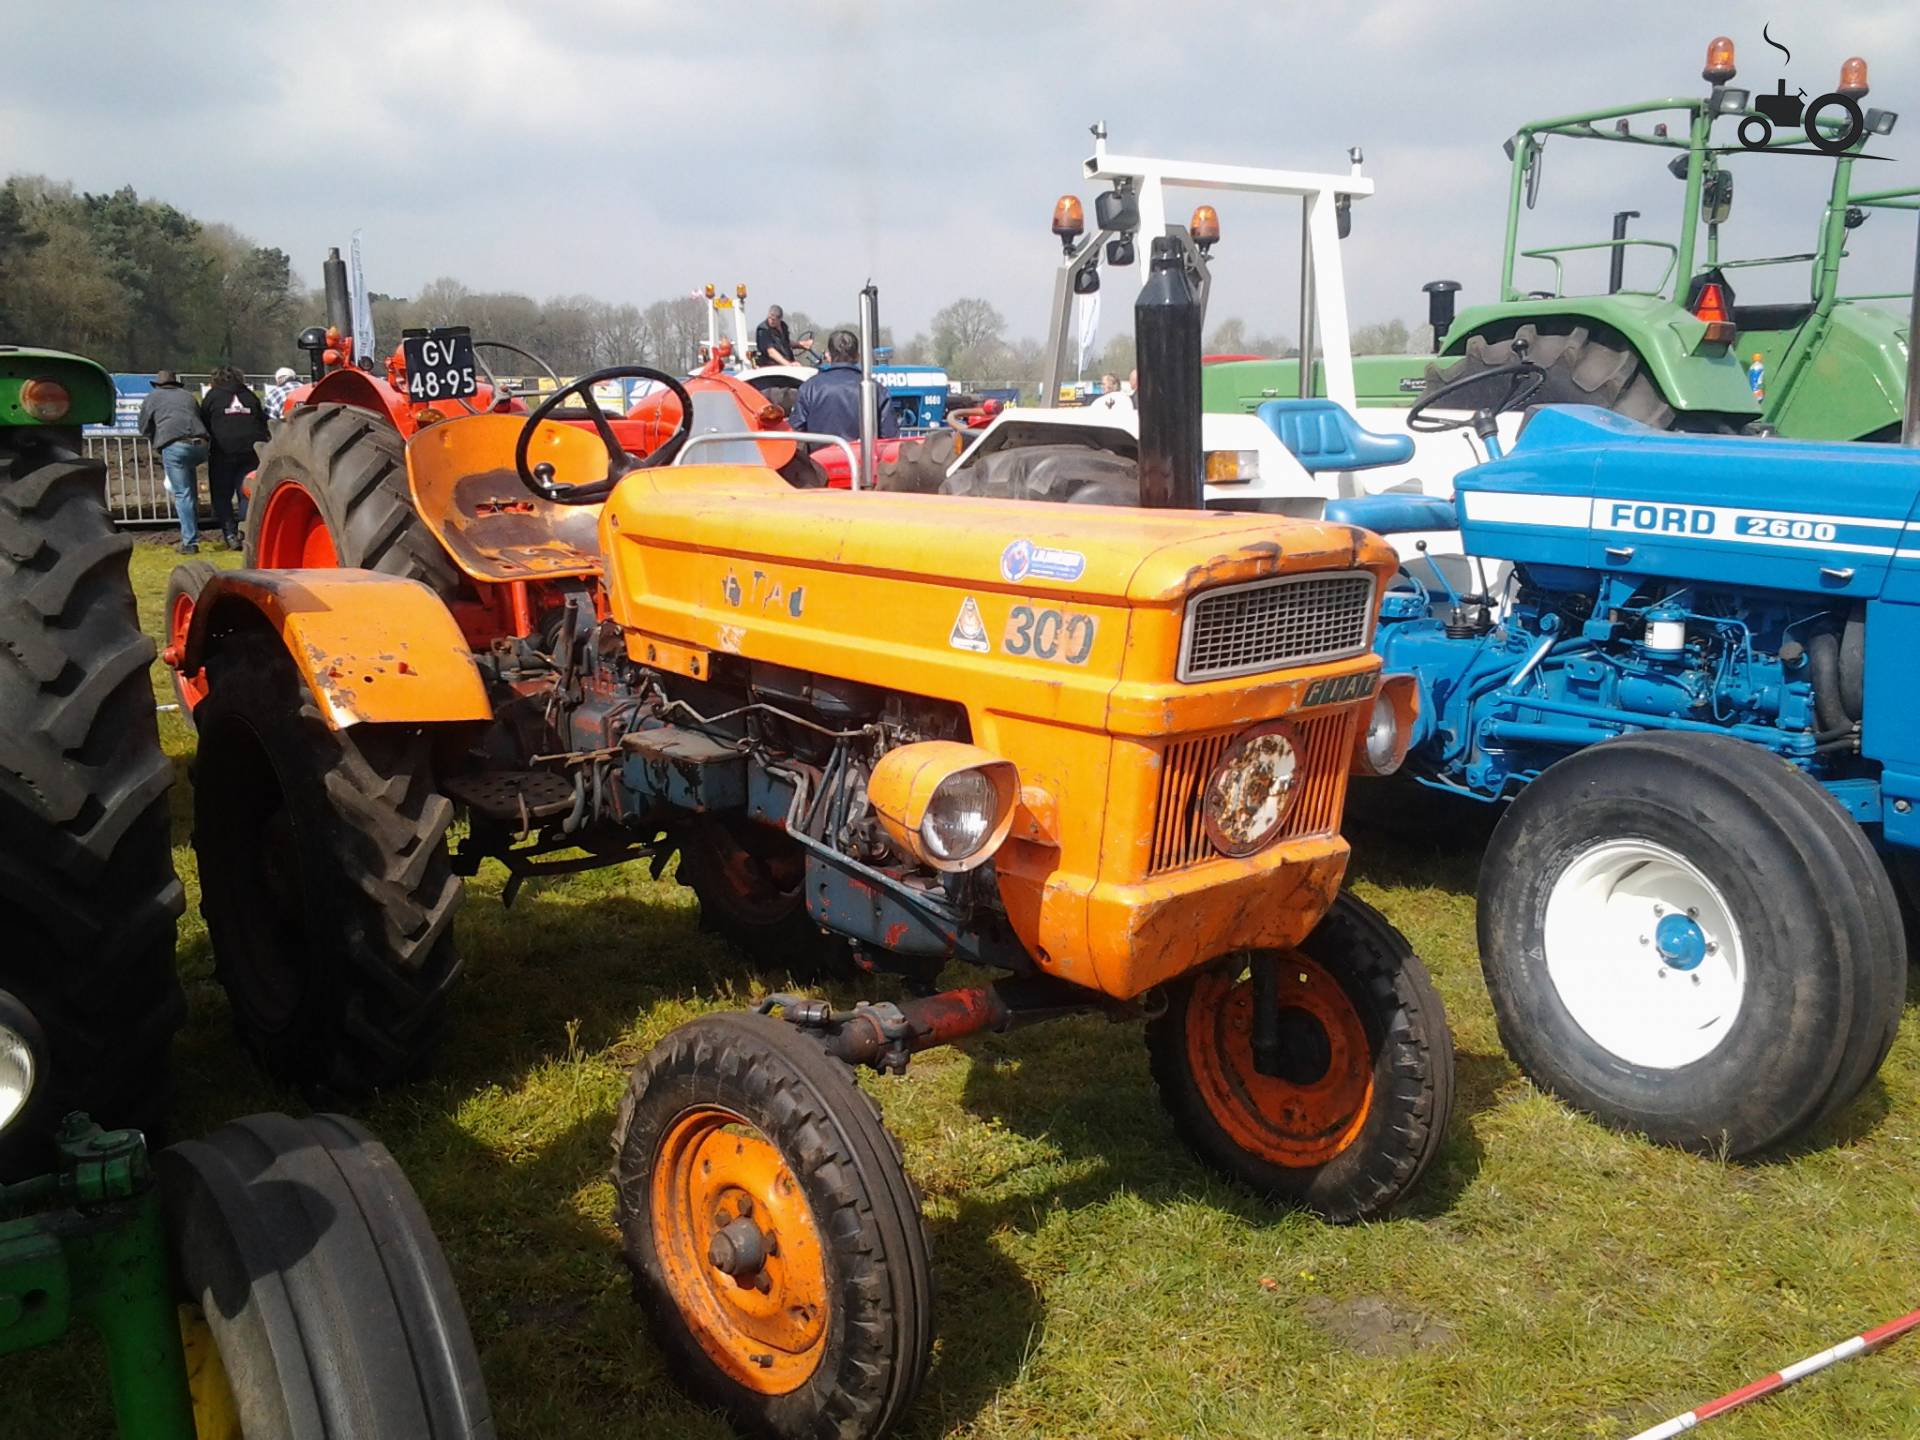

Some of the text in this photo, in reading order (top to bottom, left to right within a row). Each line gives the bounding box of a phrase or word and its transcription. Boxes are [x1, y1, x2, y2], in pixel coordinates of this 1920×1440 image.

[422, 339, 456, 367] GV
[410, 367, 476, 399] 48-95
[1610, 503, 1837, 542] FORD 2600
[1005, 606, 1095, 665] 300
[1306, 672, 1378, 703] FIAT
